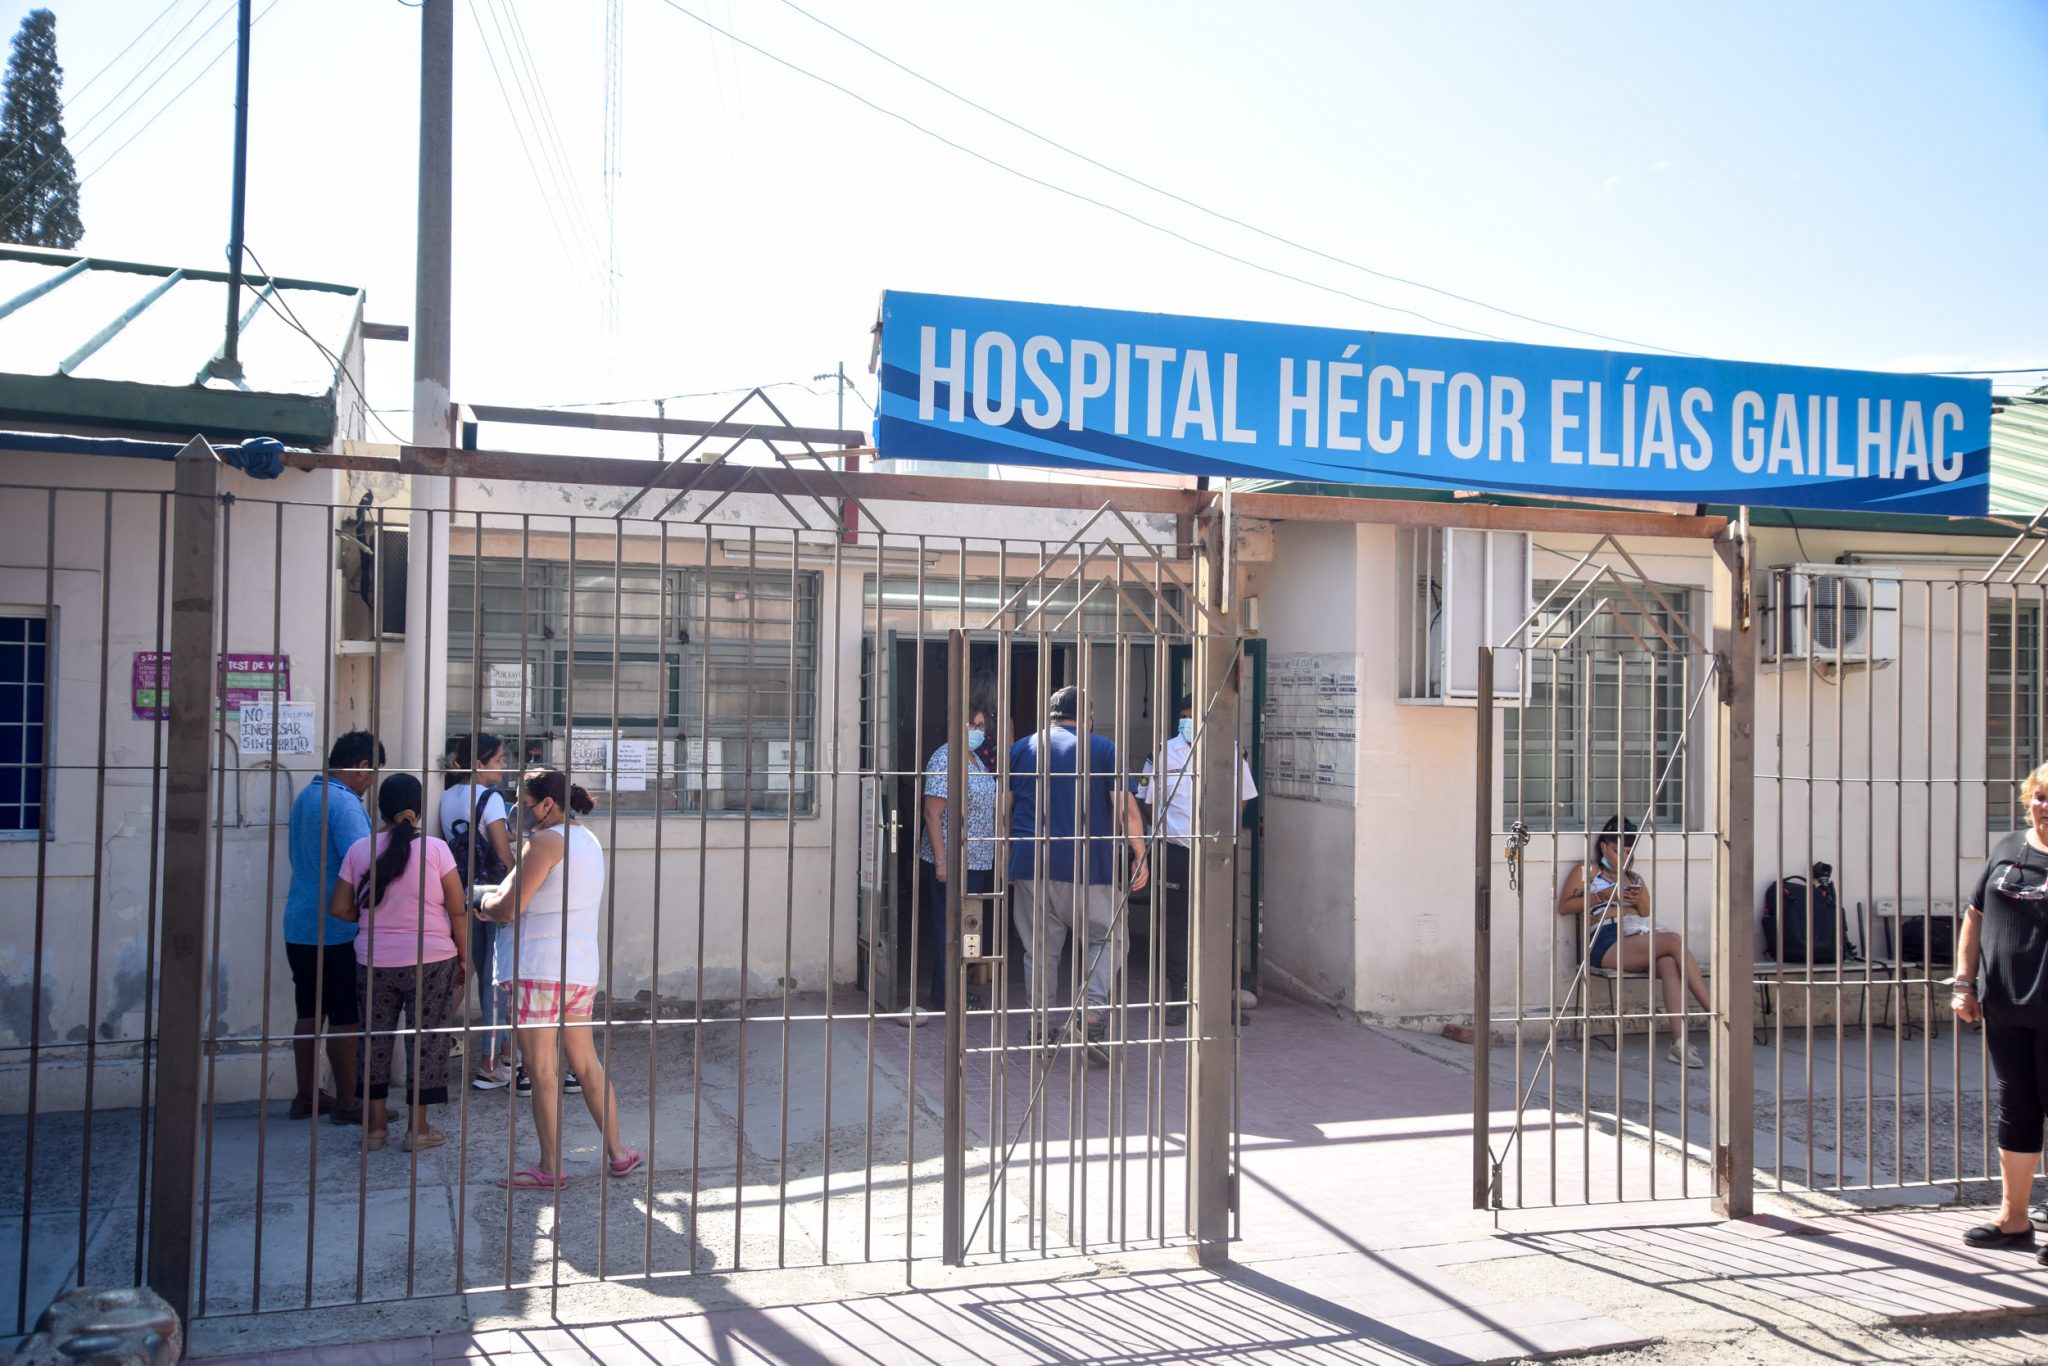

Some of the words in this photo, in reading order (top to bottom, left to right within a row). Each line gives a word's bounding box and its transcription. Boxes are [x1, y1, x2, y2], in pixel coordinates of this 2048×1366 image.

[918, 325, 1257, 445] HOSPITAL
[1278, 344, 1526, 464] HÉCTOR
[1550, 366, 1714, 472] ELÍAS
[1731, 389, 1965, 483] GAILHAC
[228, 661, 248, 671] TEST
[252, 662, 265, 671] DE
[267, 662, 284, 671] VH
[244, 708, 263, 722] NO
[241, 723, 301, 737] INGRSAR
[243, 737, 264, 749] SIN
[266, 736, 309, 752] BRBIJO
